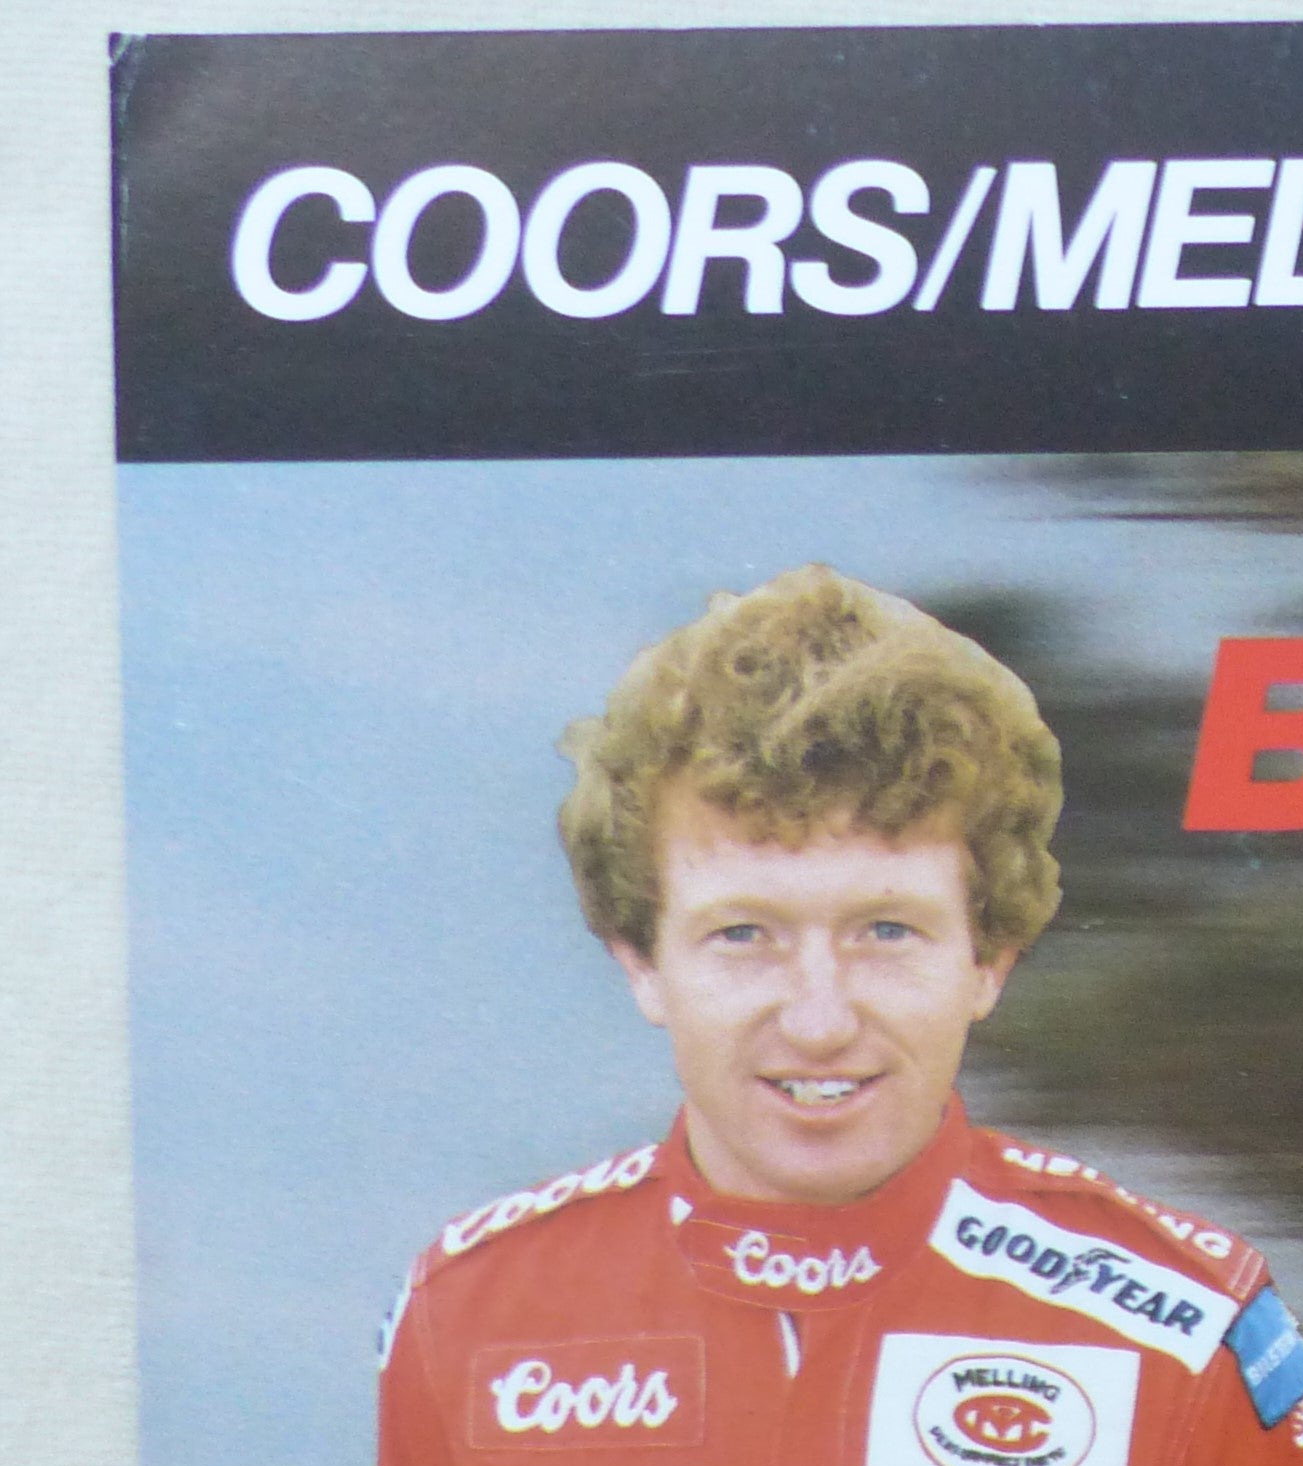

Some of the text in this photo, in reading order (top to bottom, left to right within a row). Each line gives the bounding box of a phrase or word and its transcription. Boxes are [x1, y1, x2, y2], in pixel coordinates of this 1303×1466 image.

[722, 1229, 883, 1296] Coors
[954, 1211, 1207, 1337] GOODYEAR
[490, 1358, 679, 1434] Coors
[952, 1368, 1061, 1403] MELLING
